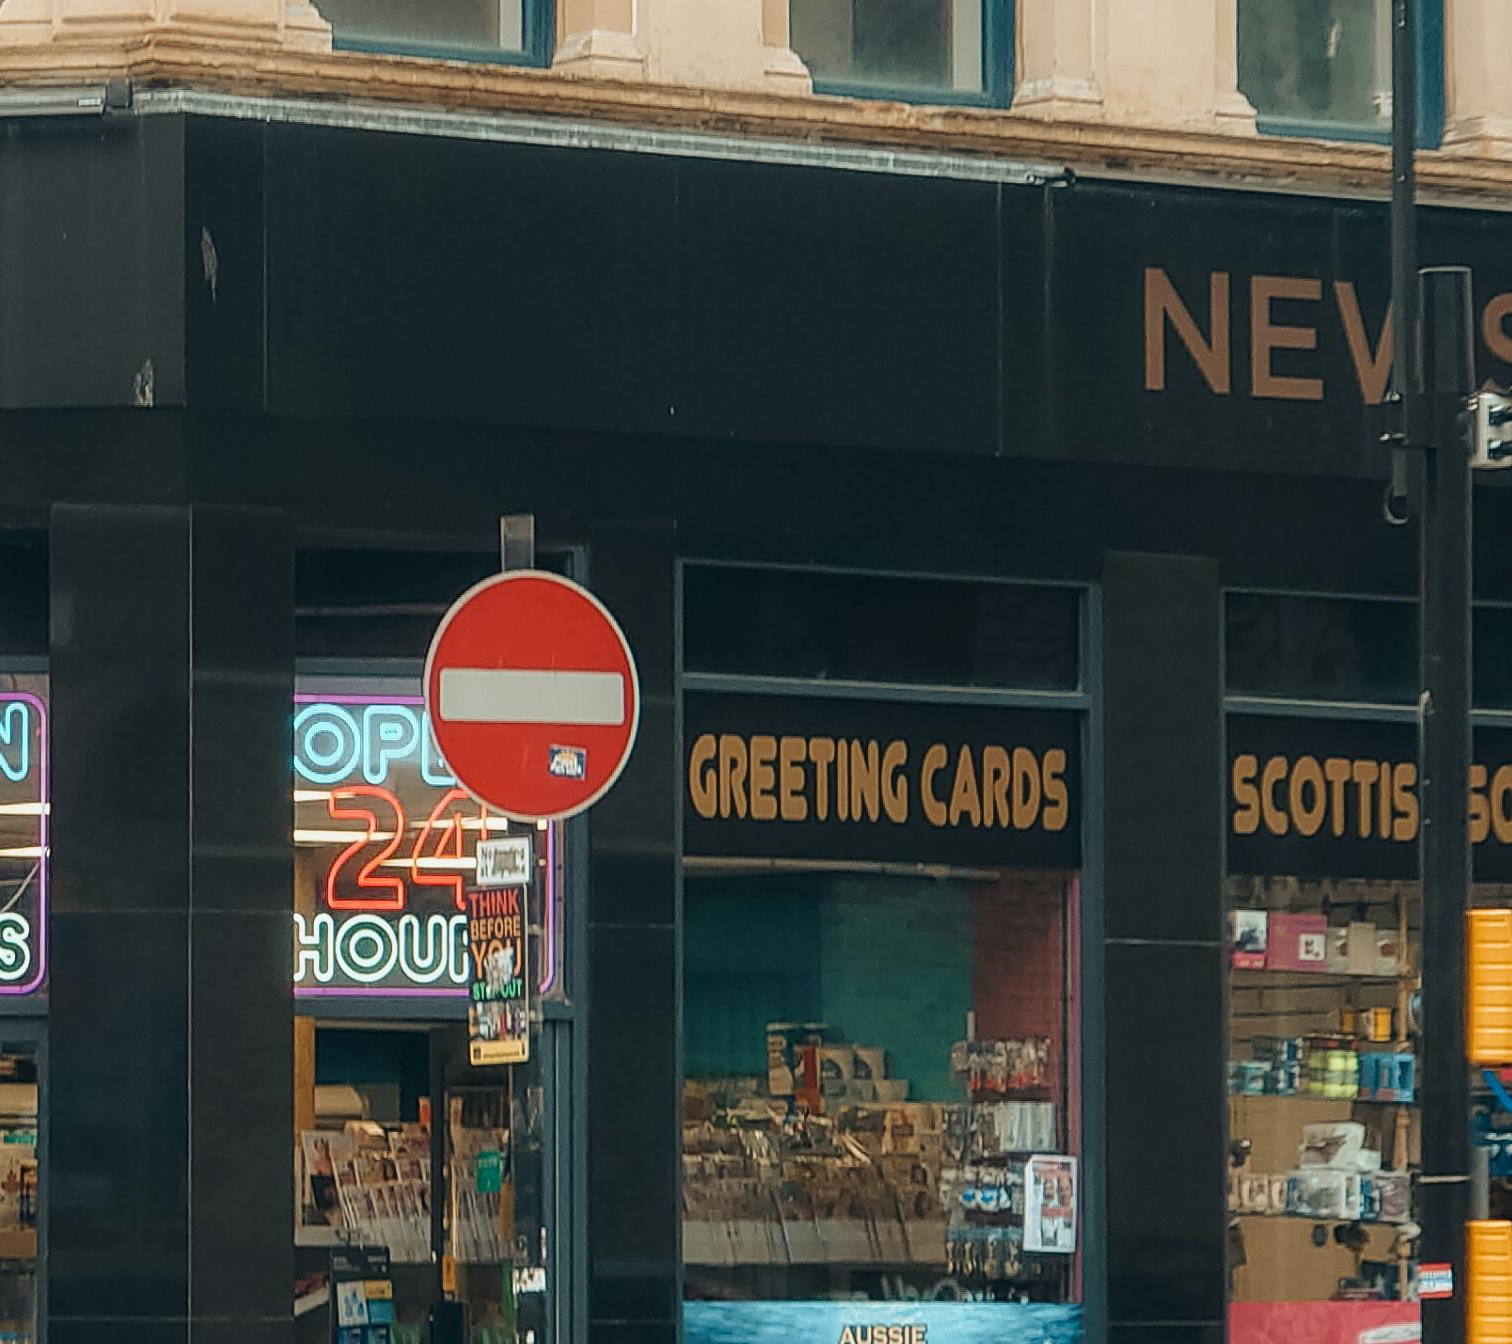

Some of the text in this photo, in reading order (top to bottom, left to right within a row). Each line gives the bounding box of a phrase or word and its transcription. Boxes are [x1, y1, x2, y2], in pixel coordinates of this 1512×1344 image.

[689, 734, 1068, 832] GREETING CARDS
[1232, 754, 1420, 842] SCOTTIS
[469, 890, 519, 920] THINK
[470, 915, 521, 941] BEFORE
[294, 913, 469, 983] HOU
